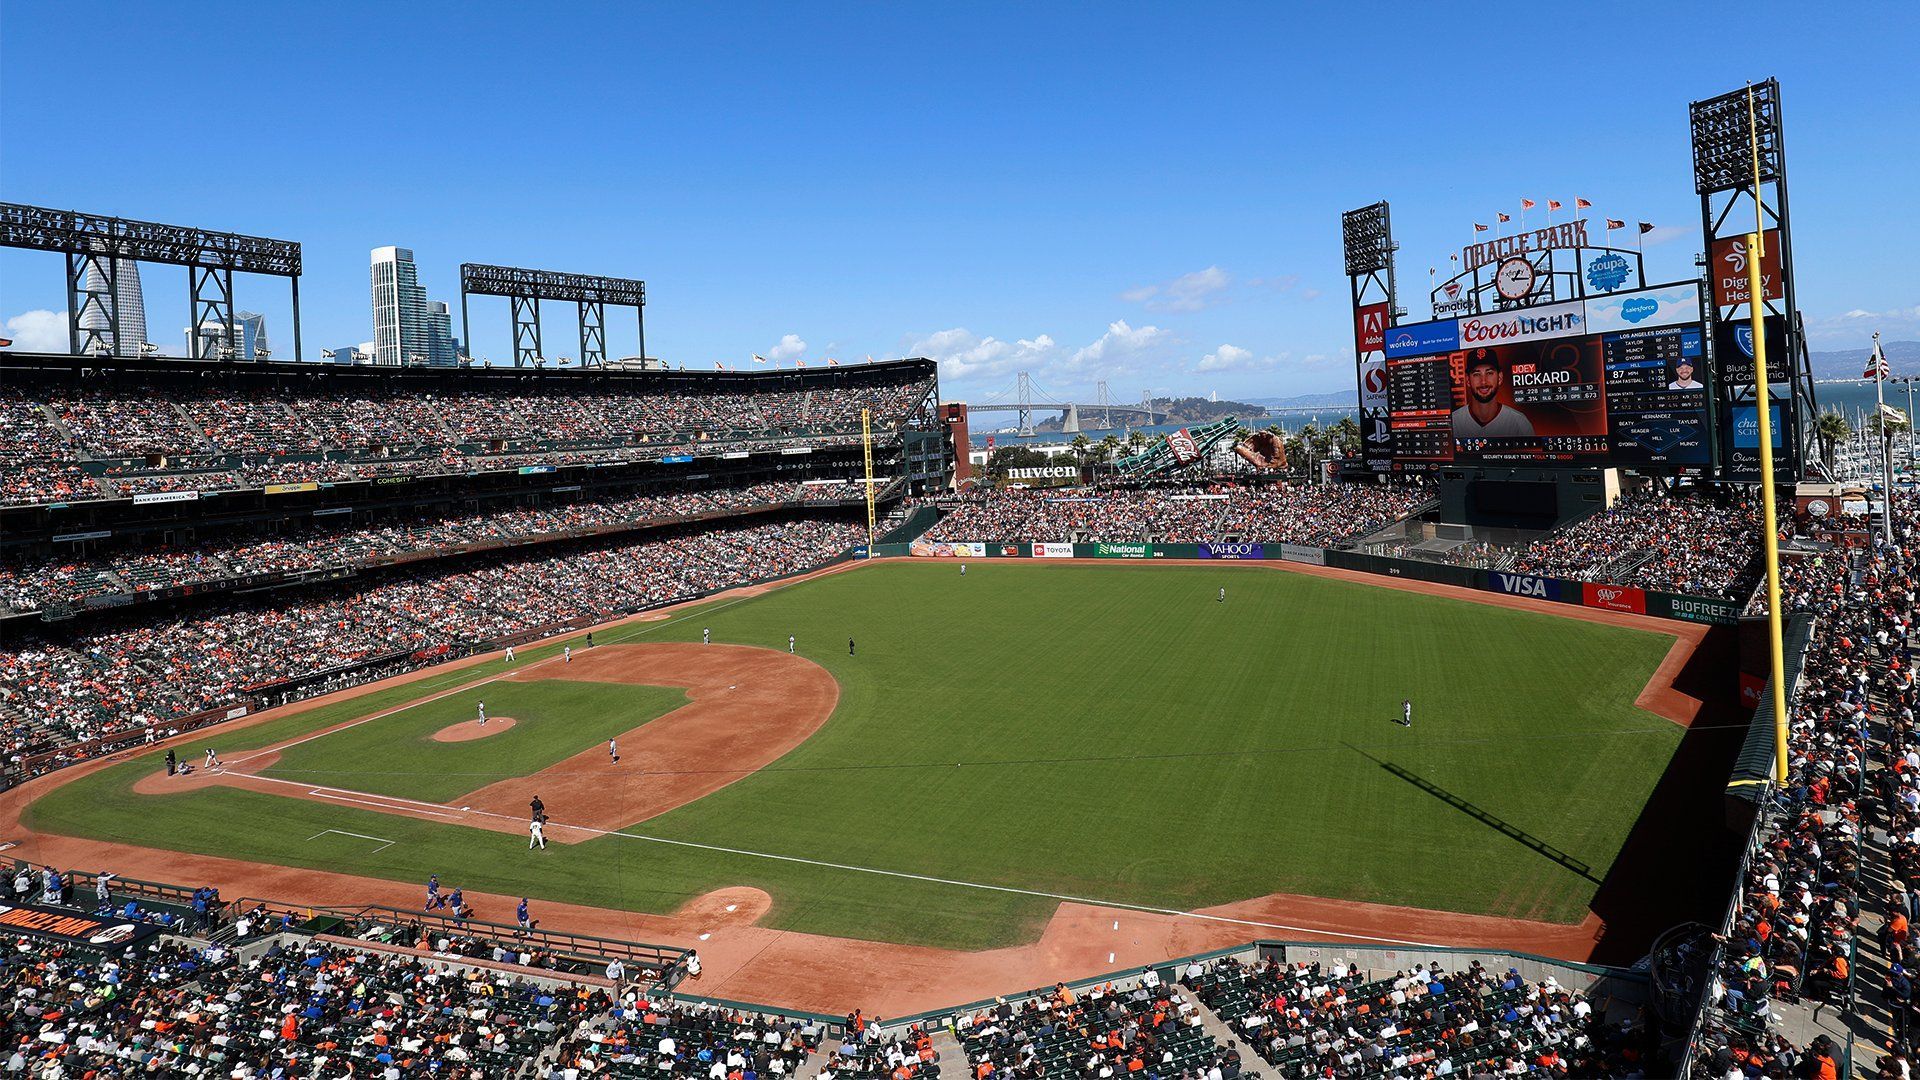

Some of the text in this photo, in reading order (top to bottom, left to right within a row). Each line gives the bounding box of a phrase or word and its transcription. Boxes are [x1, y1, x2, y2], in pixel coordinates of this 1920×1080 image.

[1463, 218, 1589, 272] ORACLE PARK
[1591, 258, 1625, 271] coupa
[1625, 302, 1655, 314] salesforce
[1463, 314, 1573, 343] Coors LIGHT
[1364, 336, 1383, 345] Adobe
[1389, 338, 1418, 349] workday
[1513, 364, 1535, 373] JOEY
[1513, 371, 1569, 386] RICKARD
[1008, 466, 1077, 478] nuveen
[1109, 544, 1145, 554] National
[1208, 544, 1253, 554] YAHOO!
[1499, 574, 1546, 597] VISA
